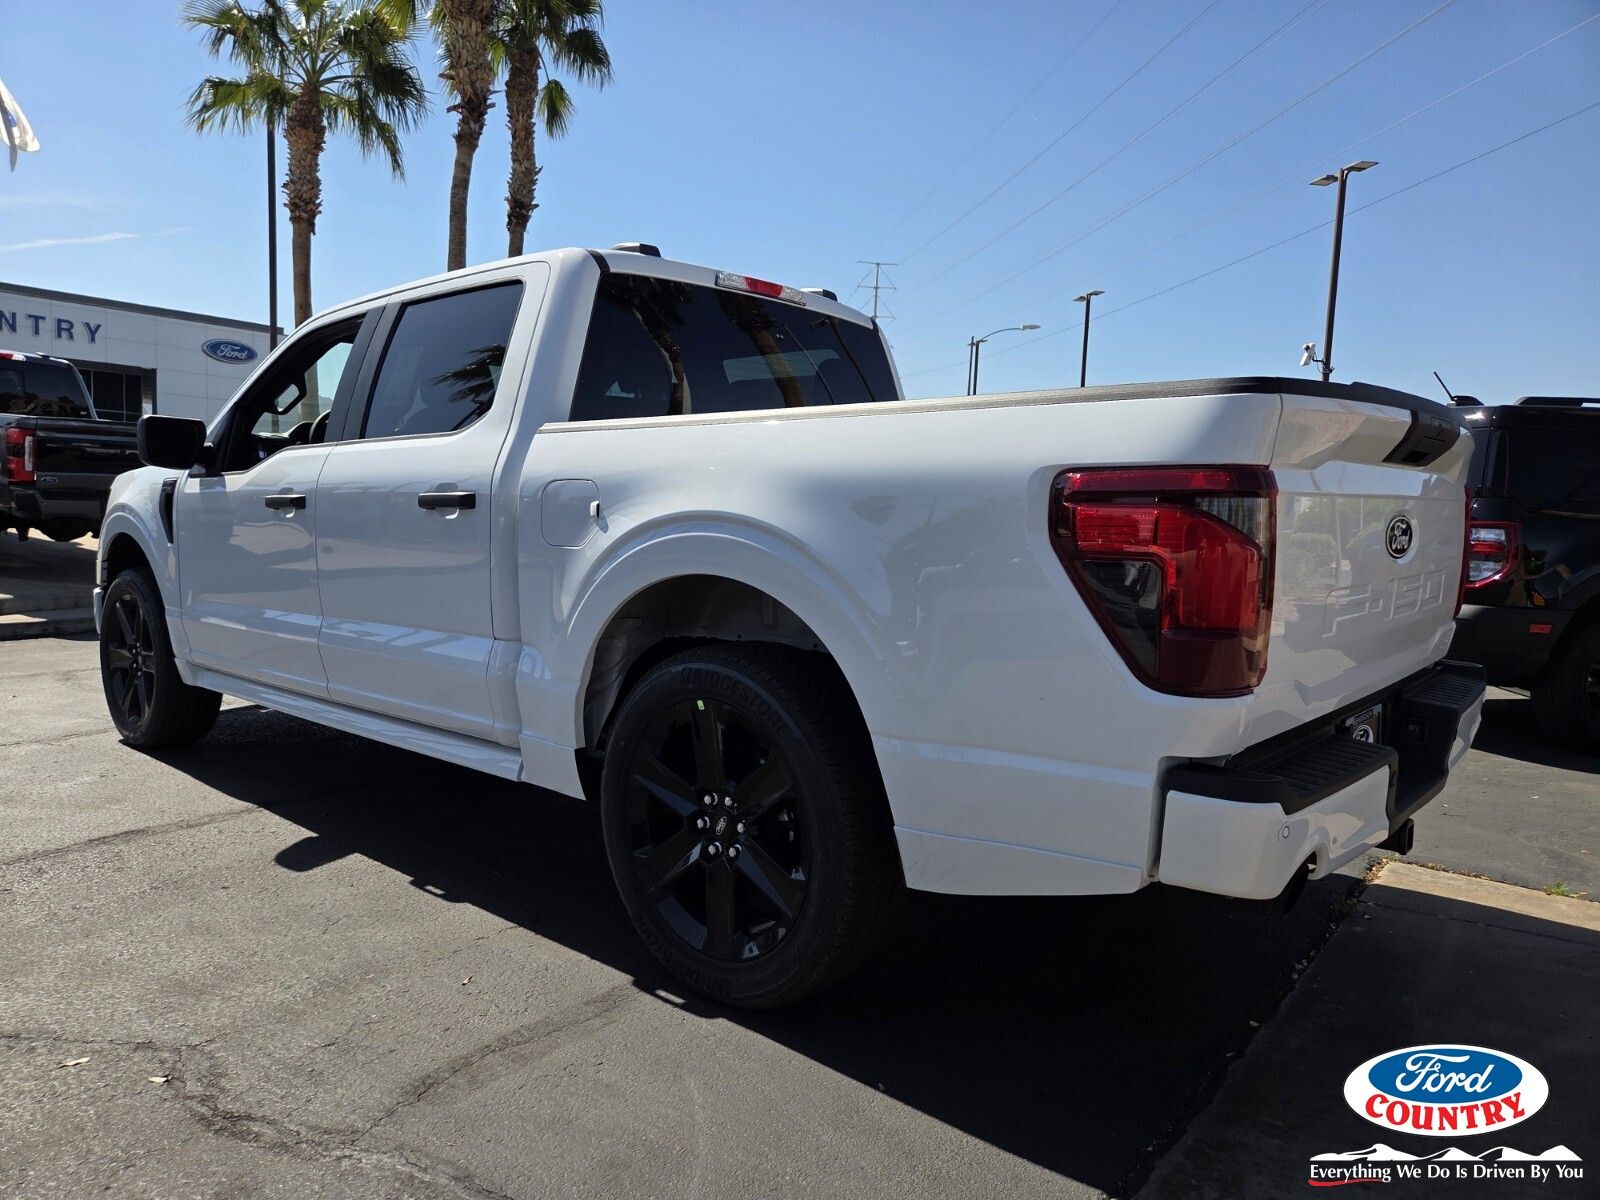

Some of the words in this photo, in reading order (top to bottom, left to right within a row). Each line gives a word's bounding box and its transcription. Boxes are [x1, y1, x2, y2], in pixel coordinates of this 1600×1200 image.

[0, 310, 102, 343] NTRY
[217, 343, 249, 360] Ford
[1391, 521, 1411, 550] Ford
